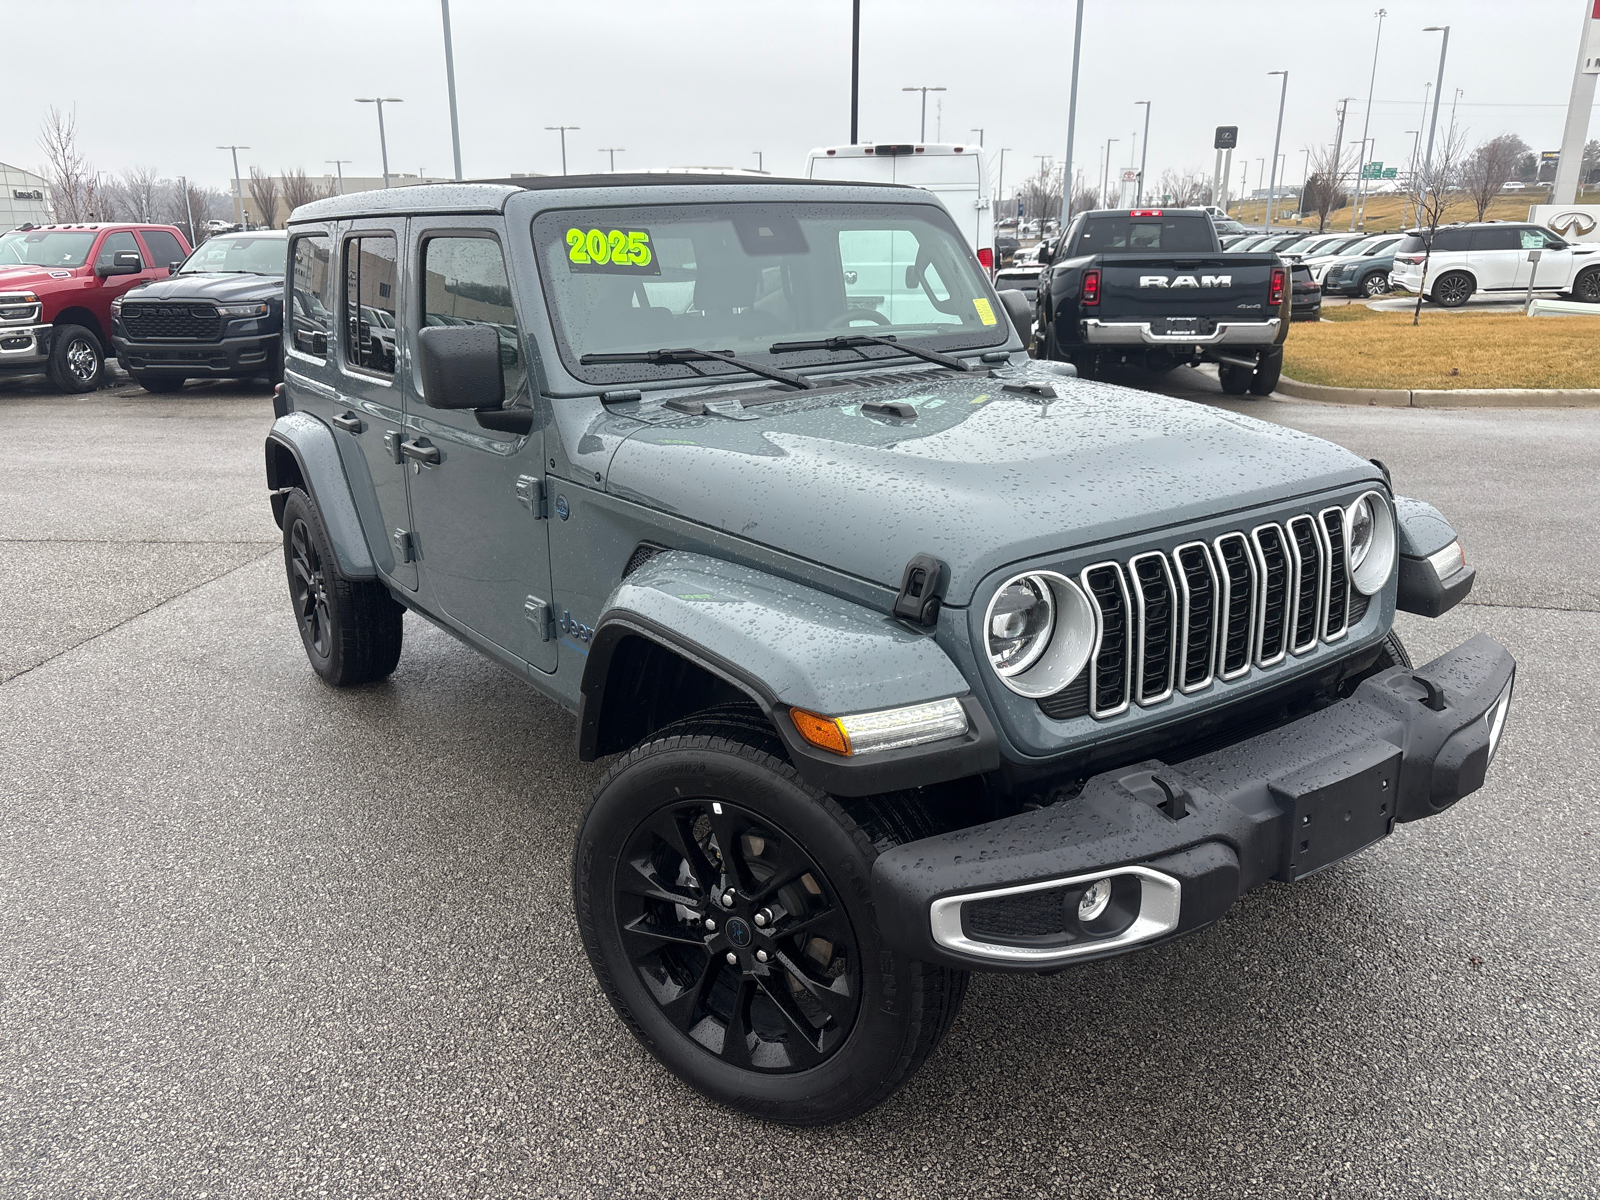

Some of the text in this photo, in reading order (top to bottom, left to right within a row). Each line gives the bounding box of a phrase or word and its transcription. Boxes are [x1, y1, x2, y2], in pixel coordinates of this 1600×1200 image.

[566, 228, 652, 267] 2025
[1139, 275, 1232, 288] RAM
[142, 307, 189, 316] RAM
